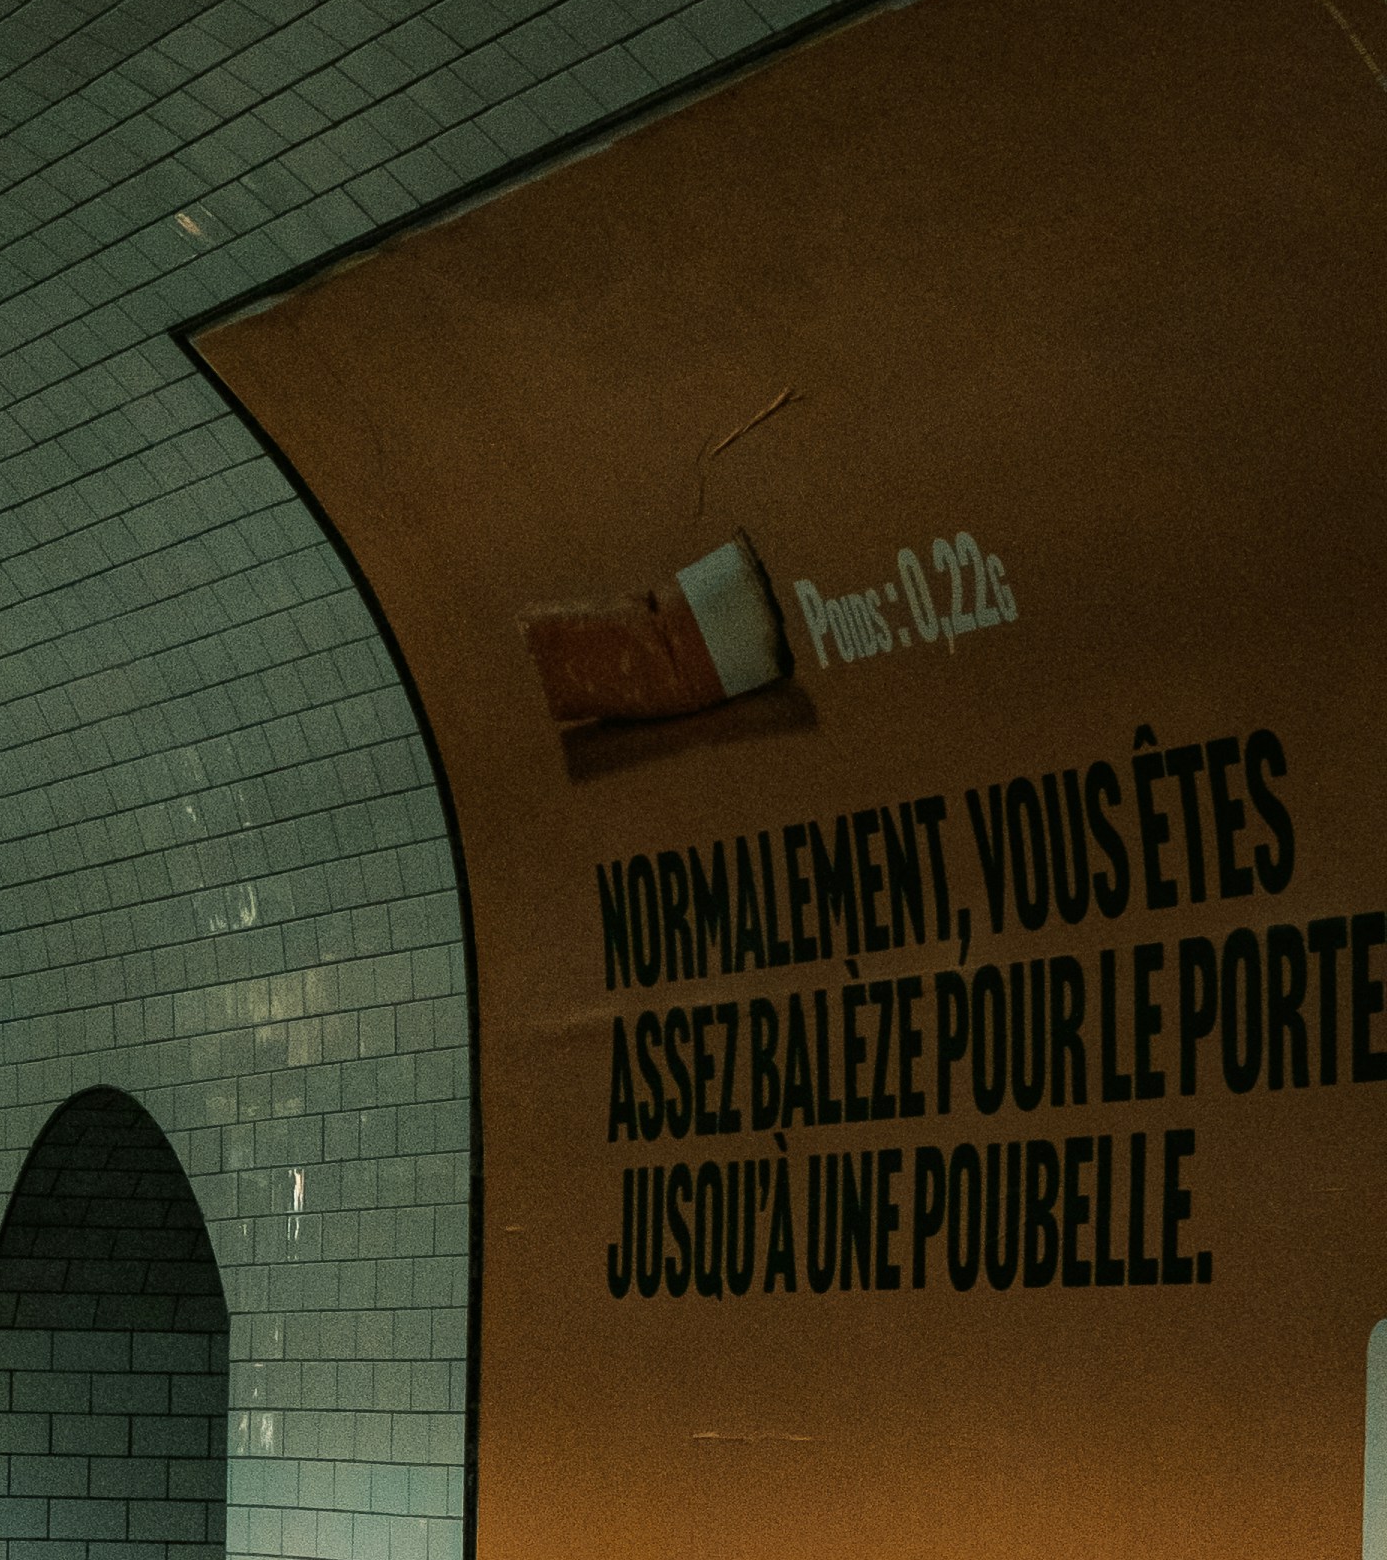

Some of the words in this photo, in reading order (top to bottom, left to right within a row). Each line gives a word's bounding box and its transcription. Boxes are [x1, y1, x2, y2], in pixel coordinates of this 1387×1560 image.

[597, 794, 972, 992] NORMALEMENT,
[967, 759, 1130, 935] VOUS
[1132, 724, 1297, 912] ÊTES
[608, 1001, 741, 1142] ASSEZ
[749, 960, 926, 1132] BALÈZE
[935, 956, 1087, 1117] POUR
[1101, 941, 1165, 1103] LE
[1178, 910, 1387, 1097] PORTE
[606, 1132, 797, 1302] JUSQU'À
[807, 1148, 902, 1295] UNE
[911, 1128, 1212, 1292] POUBELLE.
